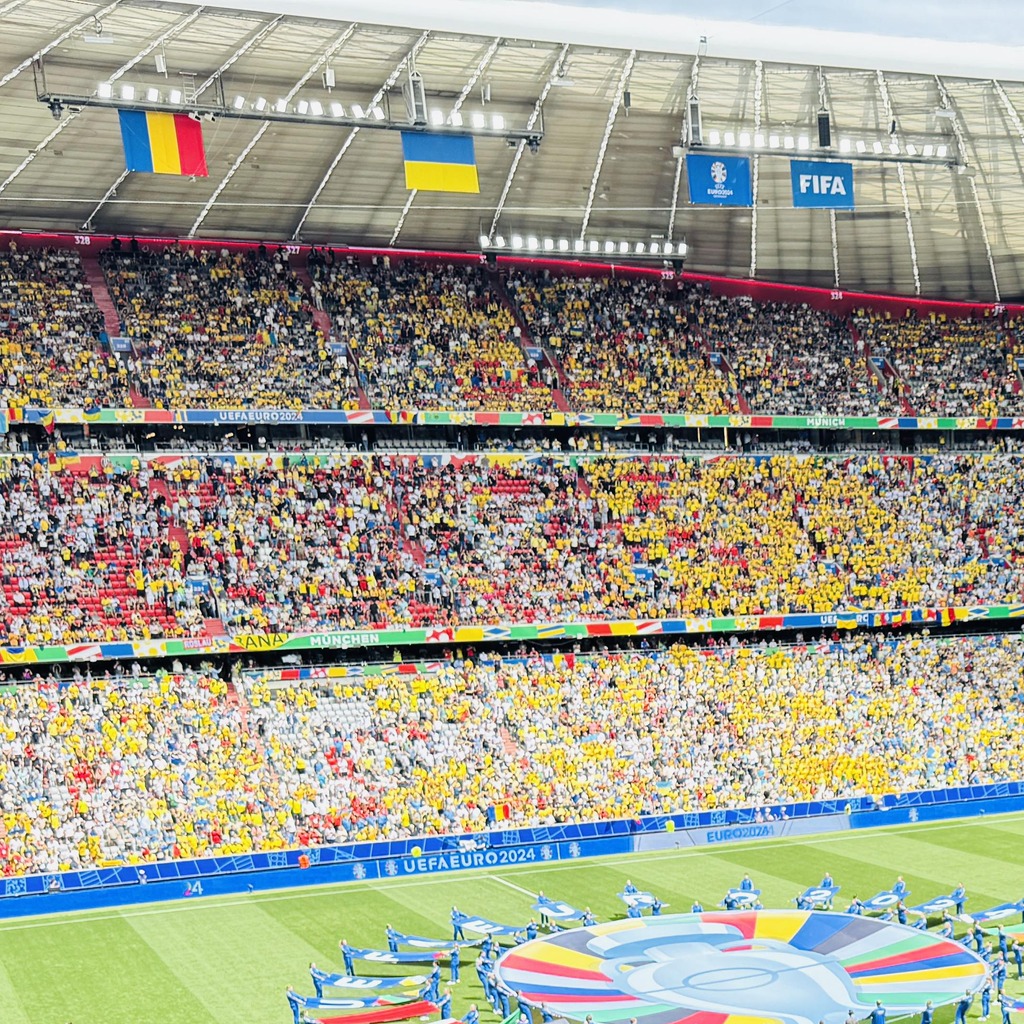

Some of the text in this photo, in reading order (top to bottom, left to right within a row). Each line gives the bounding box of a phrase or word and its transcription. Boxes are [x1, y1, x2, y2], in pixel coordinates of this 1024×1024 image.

[800, 175, 846, 195] FIFA
[74, 236, 90, 246] 328
[806, 417, 846, 427] MUNICH
[310, 632, 379, 646] MÜNCHEN
